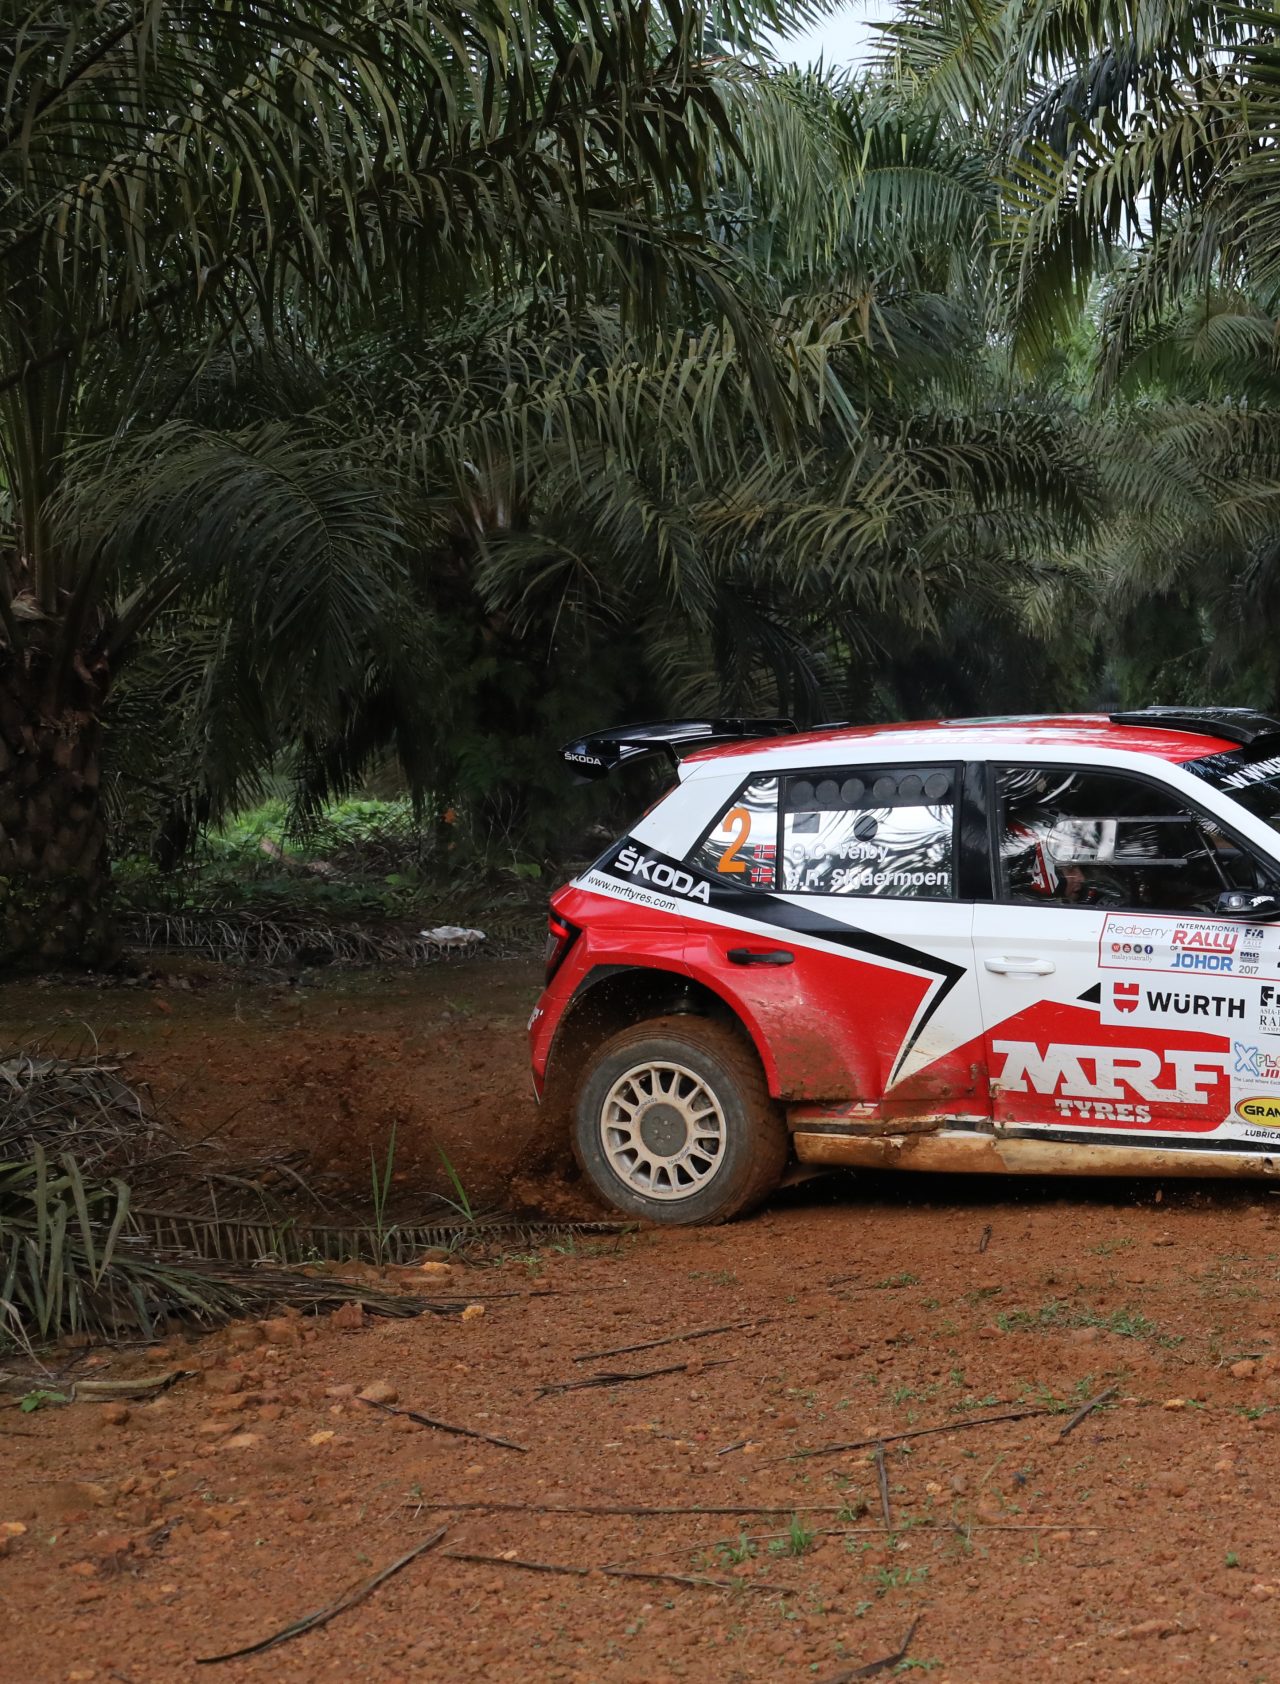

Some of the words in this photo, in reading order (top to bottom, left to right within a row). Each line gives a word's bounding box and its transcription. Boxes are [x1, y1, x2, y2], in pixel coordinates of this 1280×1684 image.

[564, 752, 602, 766] ŠKODA
[718, 808, 752, 873] 2
[614, 846, 711, 904] ŠKODA
[587, 875, 676, 911] www.mrftyres.com
[1106, 923, 1168, 938] Redberry
[1176, 922, 1240, 933] INTERNATIONAL
[1171, 929, 1239, 950] RALLY
[1169, 953, 1234, 971] JOHOR
[1238, 965, 1260, 974] 2017
[1146, 991, 1246, 1019] WÜRTH
[989, 1040, 1230, 1104] MRF
[1054, 1098, 1152, 1123] TYRES
